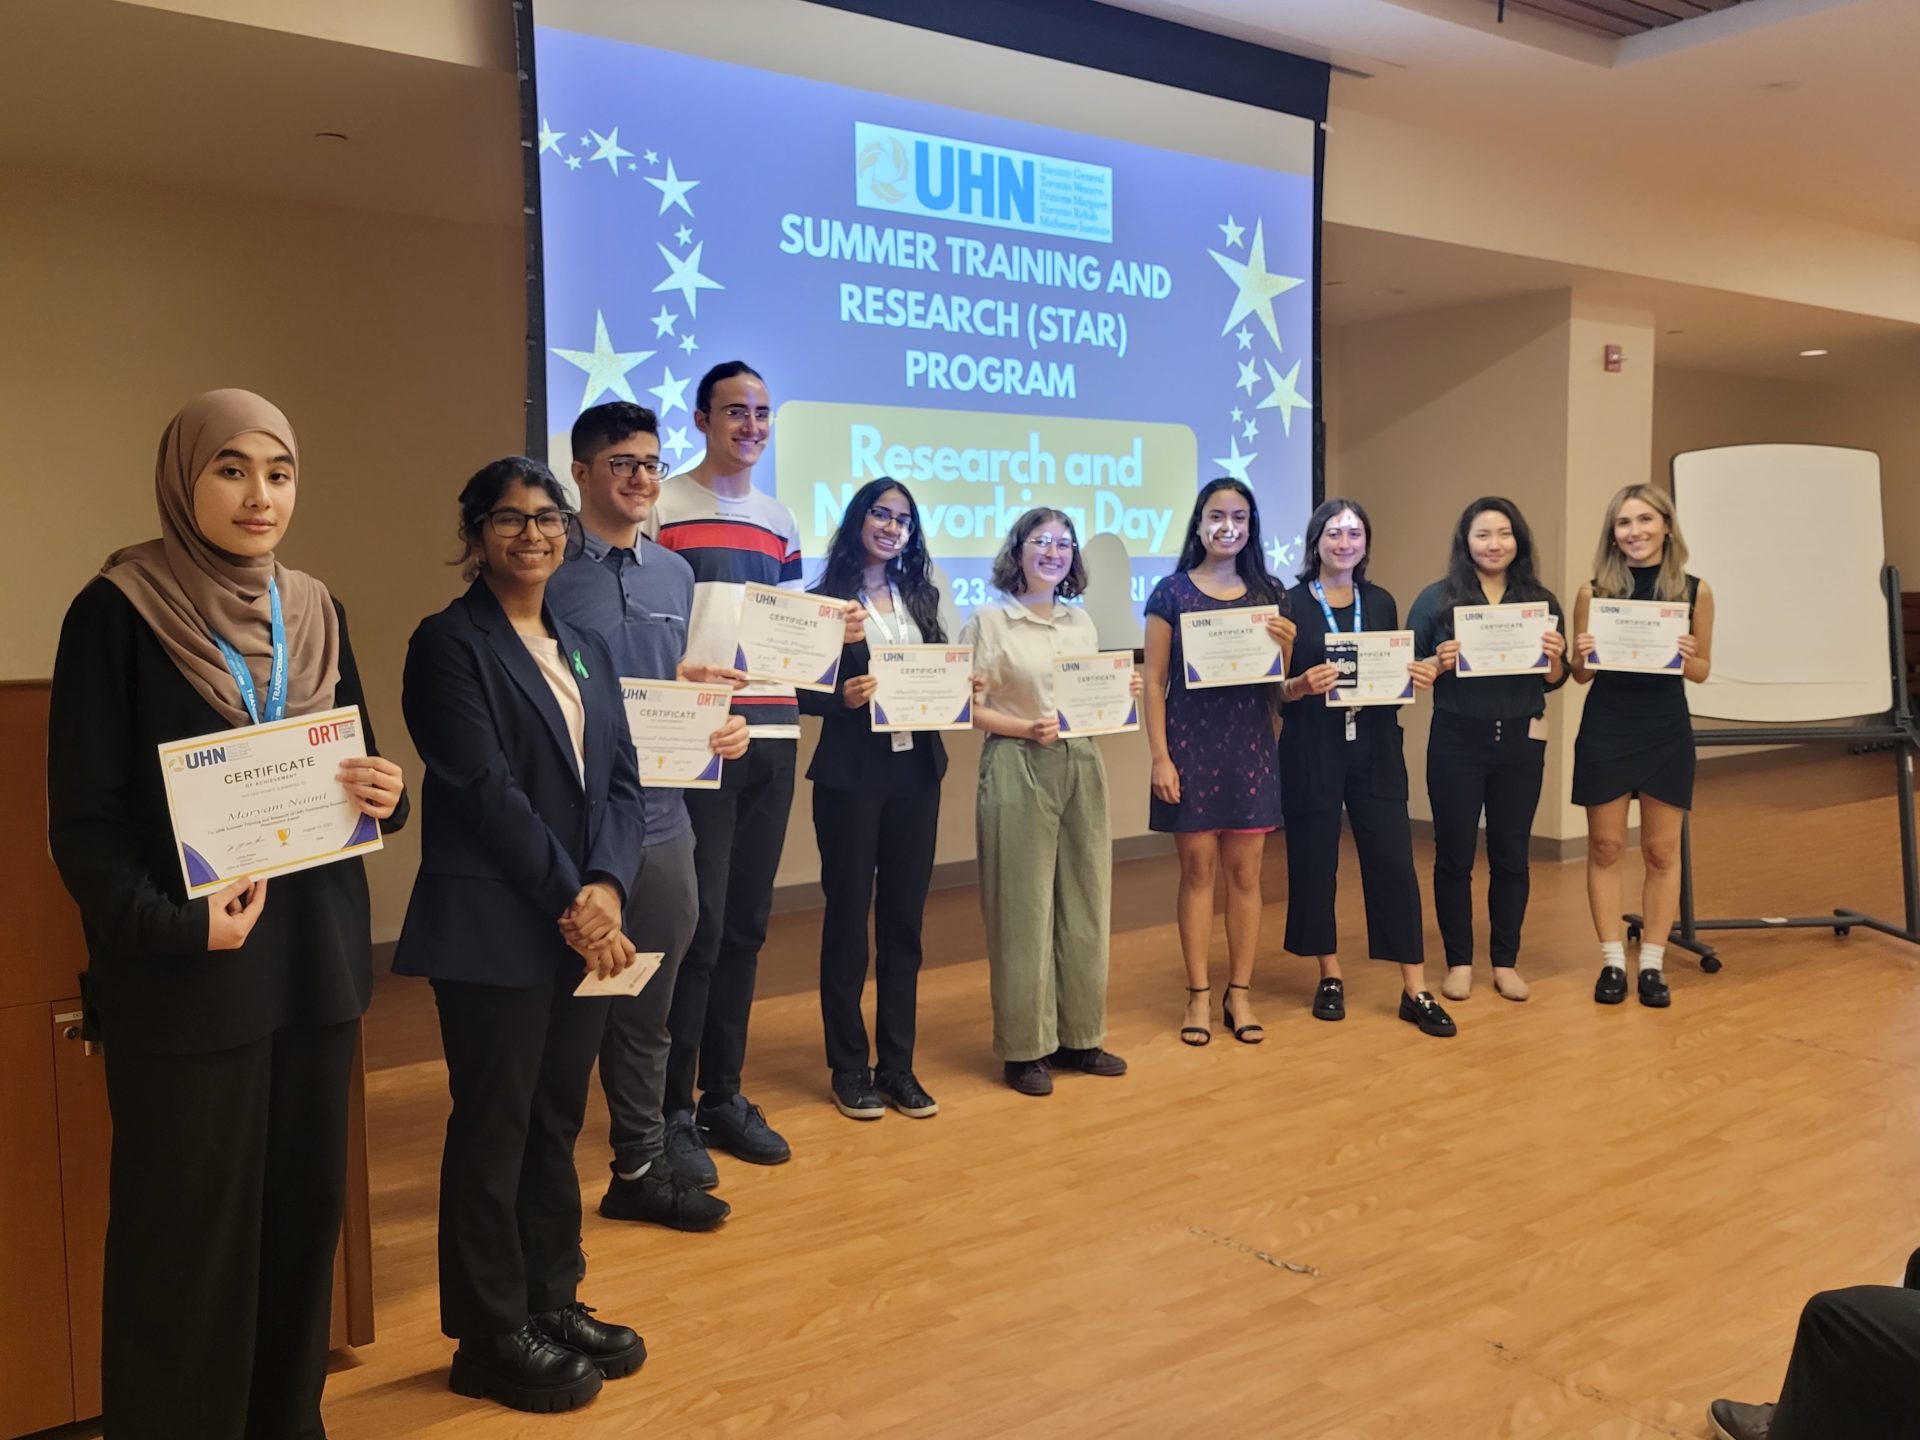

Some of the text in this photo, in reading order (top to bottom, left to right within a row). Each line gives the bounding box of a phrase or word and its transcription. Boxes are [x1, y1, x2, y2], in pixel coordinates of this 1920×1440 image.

[915, 140, 1035, 224] UHN
[779, 213, 1172, 300] SUMMER TRAINING AND
[840, 282, 1128, 358] RESEARCH (STAR)
[905, 349, 1077, 399] PROGRAM
[850, 423, 1143, 487] Research and
[1095, 490, 1174, 554] Day
[755, 592, 777, 606] UHN
[770, 612, 819, 628] CERTIFICATE
[883, 652, 904, 662] UHN
[900, 667, 947, 675] CERTIFICATE
[623, 688, 648, 700] UHN
[640, 708, 697, 720] CERTIFICATE
[308, 719, 355, 746] ORT
[185, 746, 227, 770] UHN
[224, 756, 316, 785] CERTIFICATE
[255, 773, 297, 786] ACHIEVEMENT
[228, 803, 283, 821] Maryam
[289, 792, 327, 808] Naimi
